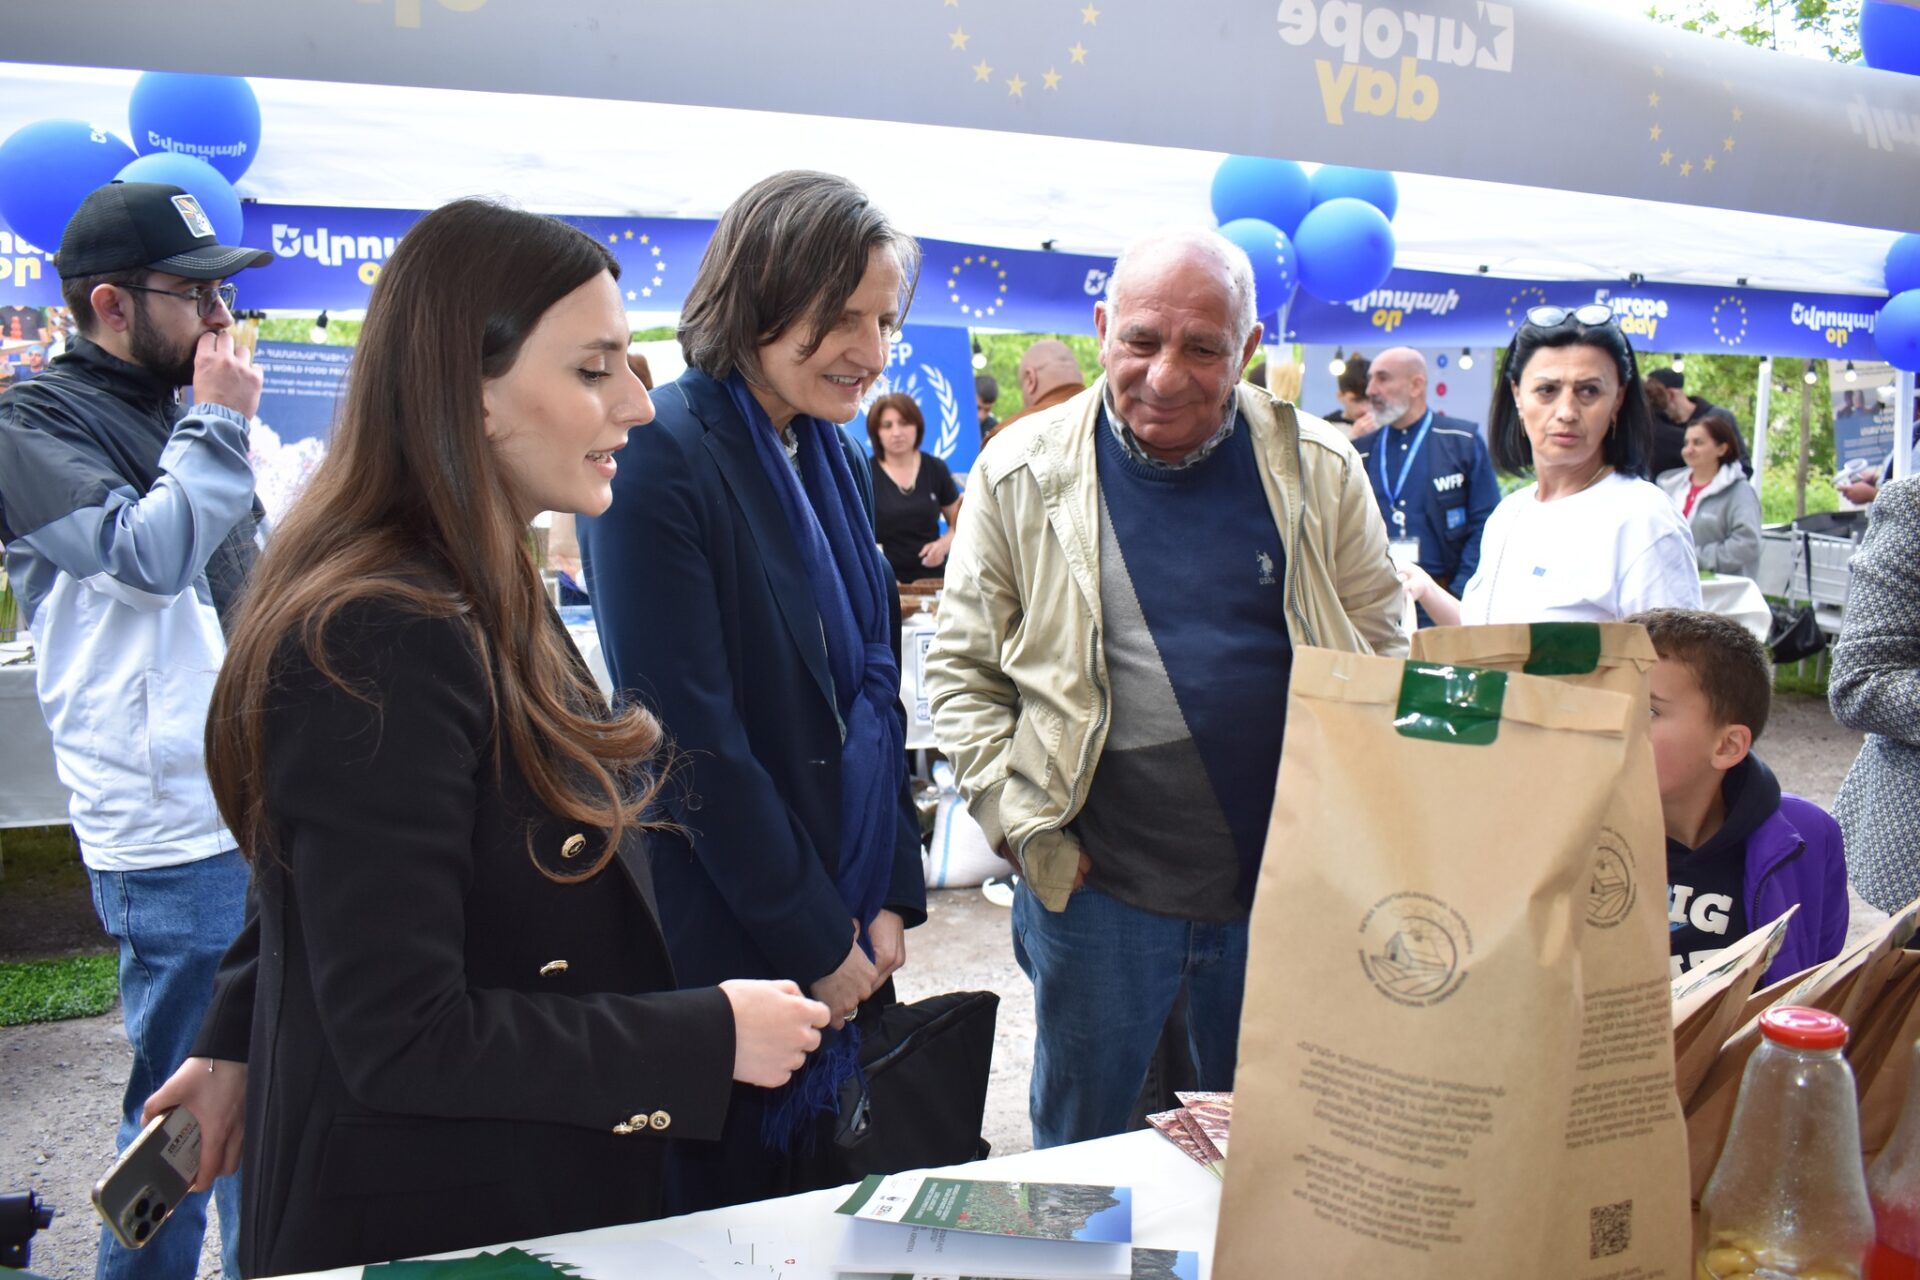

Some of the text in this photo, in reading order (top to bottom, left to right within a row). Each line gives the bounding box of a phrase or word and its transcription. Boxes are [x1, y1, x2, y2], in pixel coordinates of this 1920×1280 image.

[272, 224, 401, 266] Եվրո
[1372, 309, 1403, 333] օր
[1621, 313, 1658, 340] day
[1825, 328, 1848, 348] օր
[1433, 473, 1465, 492] WFP
